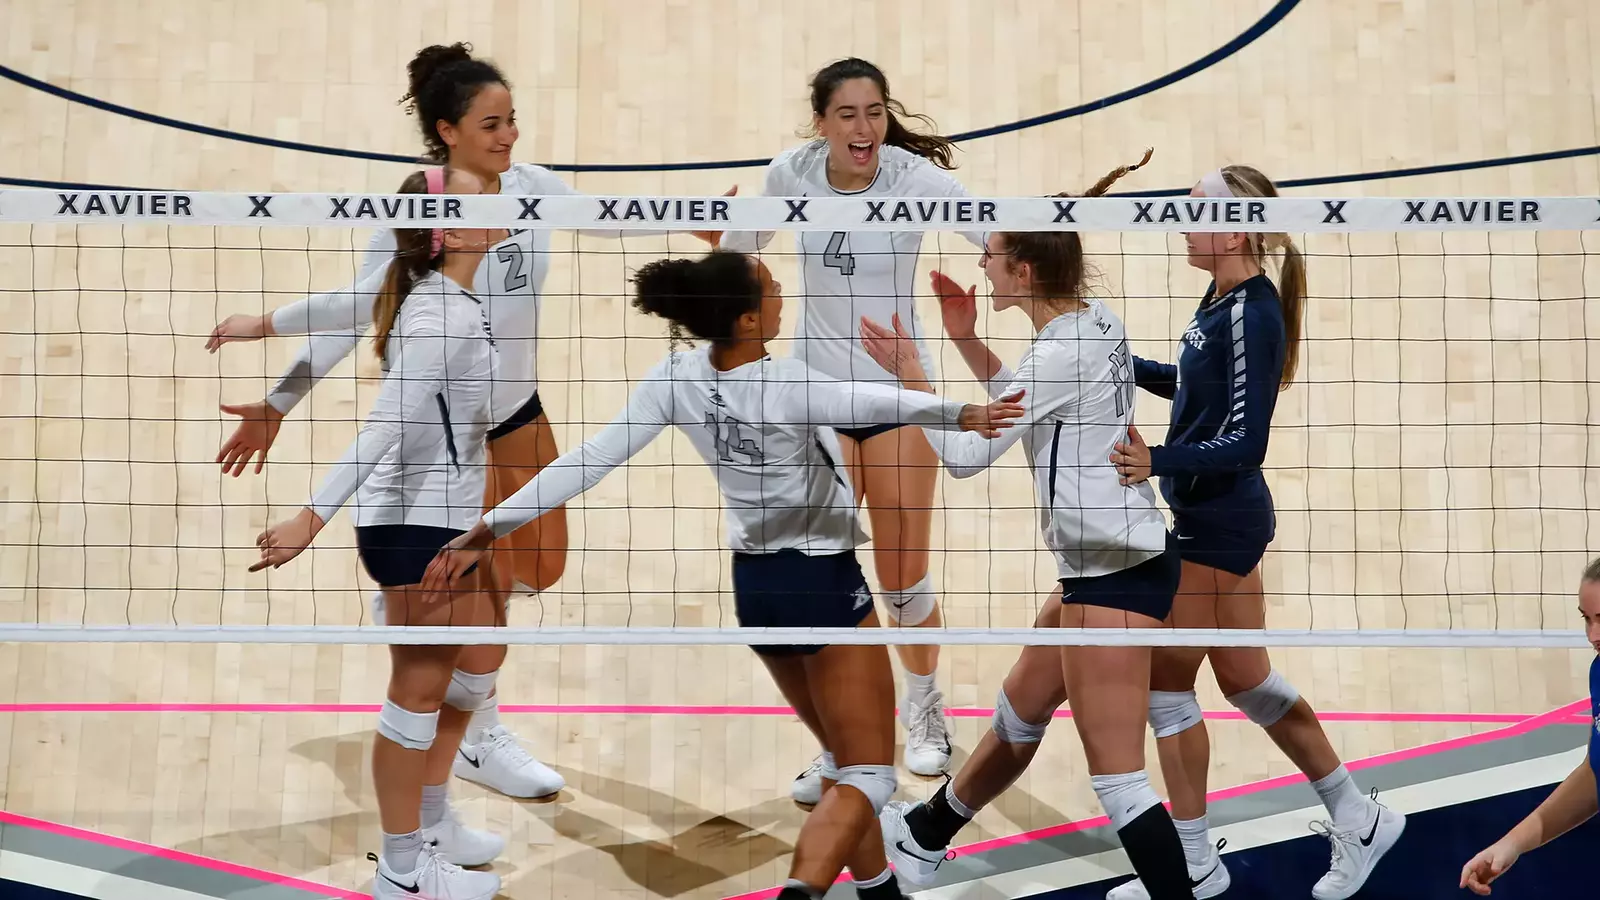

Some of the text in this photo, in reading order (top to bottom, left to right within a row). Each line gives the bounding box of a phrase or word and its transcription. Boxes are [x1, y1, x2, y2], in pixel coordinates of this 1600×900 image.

[57, 193, 1539, 224] XAVIER X XAVIER X XAVIER X XAVIER X XAVIER X XAVIER
[497, 243, 527, 292] 2
[823, 232, 856, 275] 4
[704, 411, 765, 466] 14
